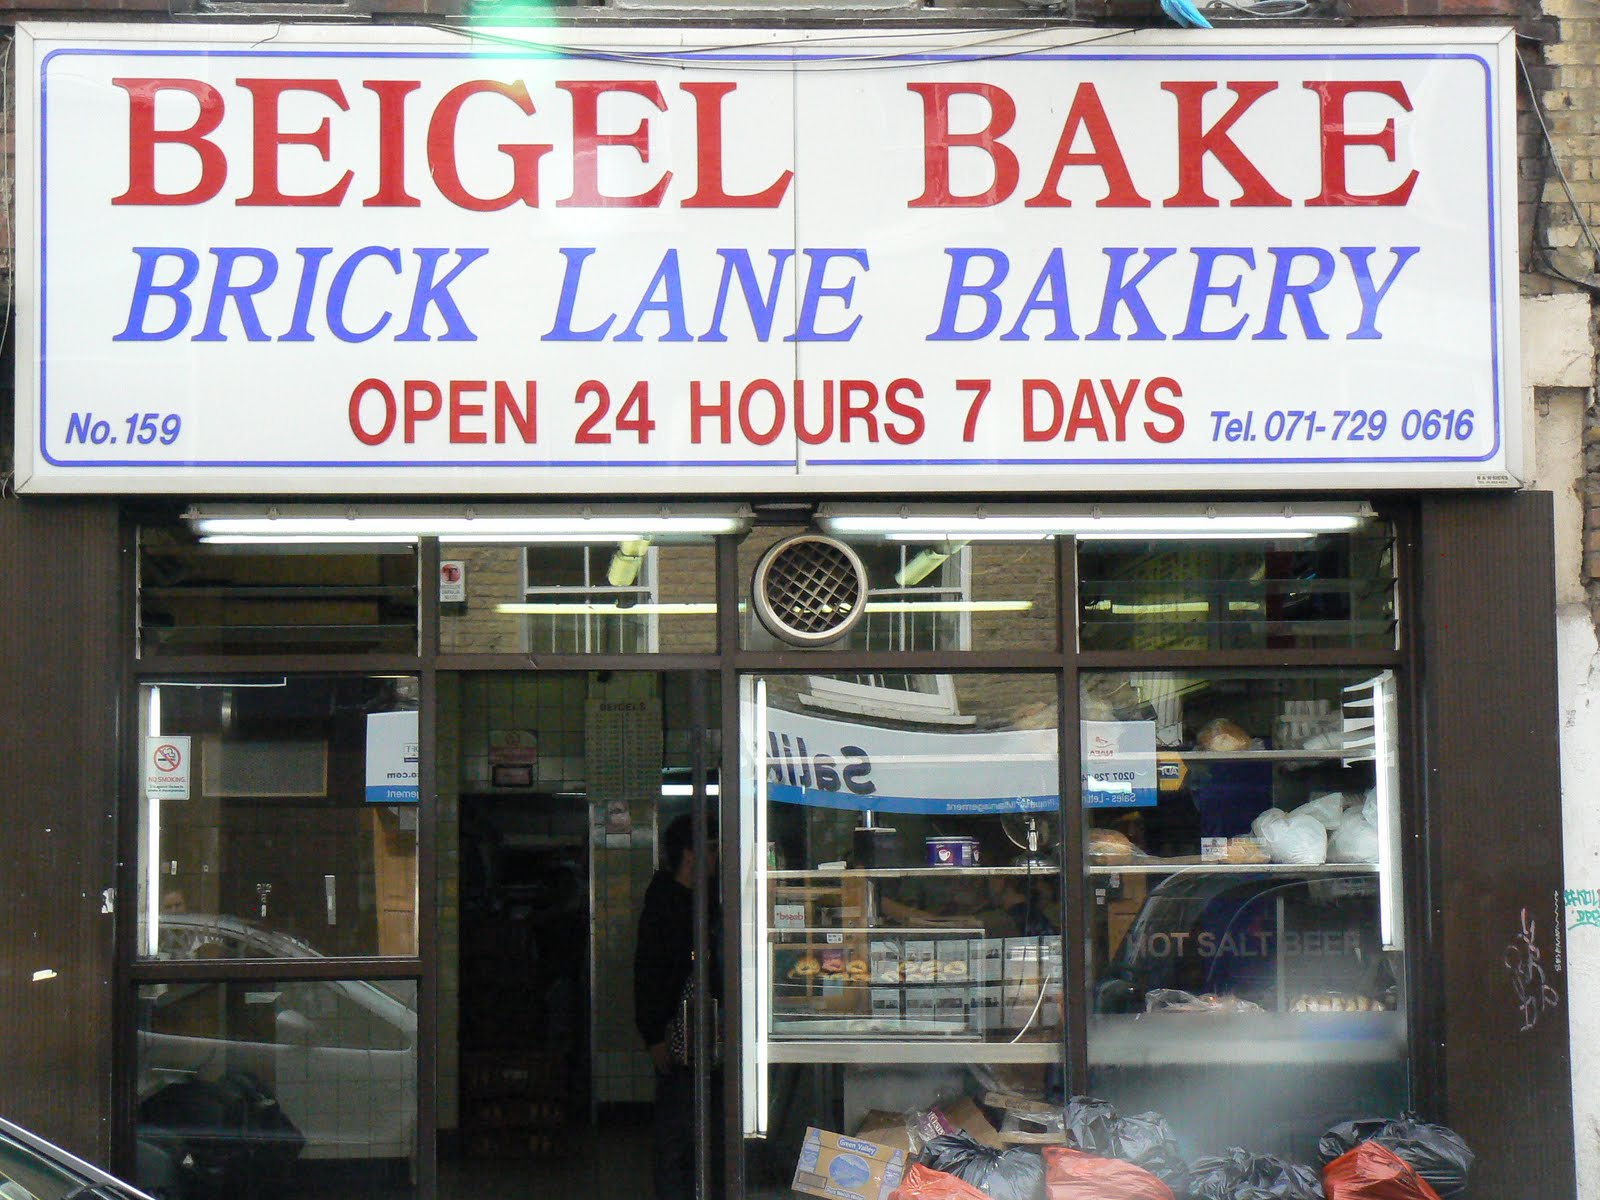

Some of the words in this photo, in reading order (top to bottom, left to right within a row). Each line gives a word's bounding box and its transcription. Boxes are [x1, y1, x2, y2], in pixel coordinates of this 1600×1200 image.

[111, 77, 794, 212] BEIGEL
[907, 80, 1420, 208] BAKE
[112, 245, 489, 344] BRICK
[541, 247, 870, 343] LANE
[926, 245, 1421, 342] BAKERY
[348, 378, 537, 446] OPEN
[574, 379, 656, 444] 24
[690, 377, 926, 446] HOURS
[955, 379, 992, 442] 7
[1022, 377, 1185, 443] DAYS
[1401, 408, 1475, 441] 0616
[1127, 932, 1190, 958] HOT
[1197, 932, 1273, 958] SALT
[839, 1138, 856, 1149] Green
[857, 1142, 876, 1155] Valley
